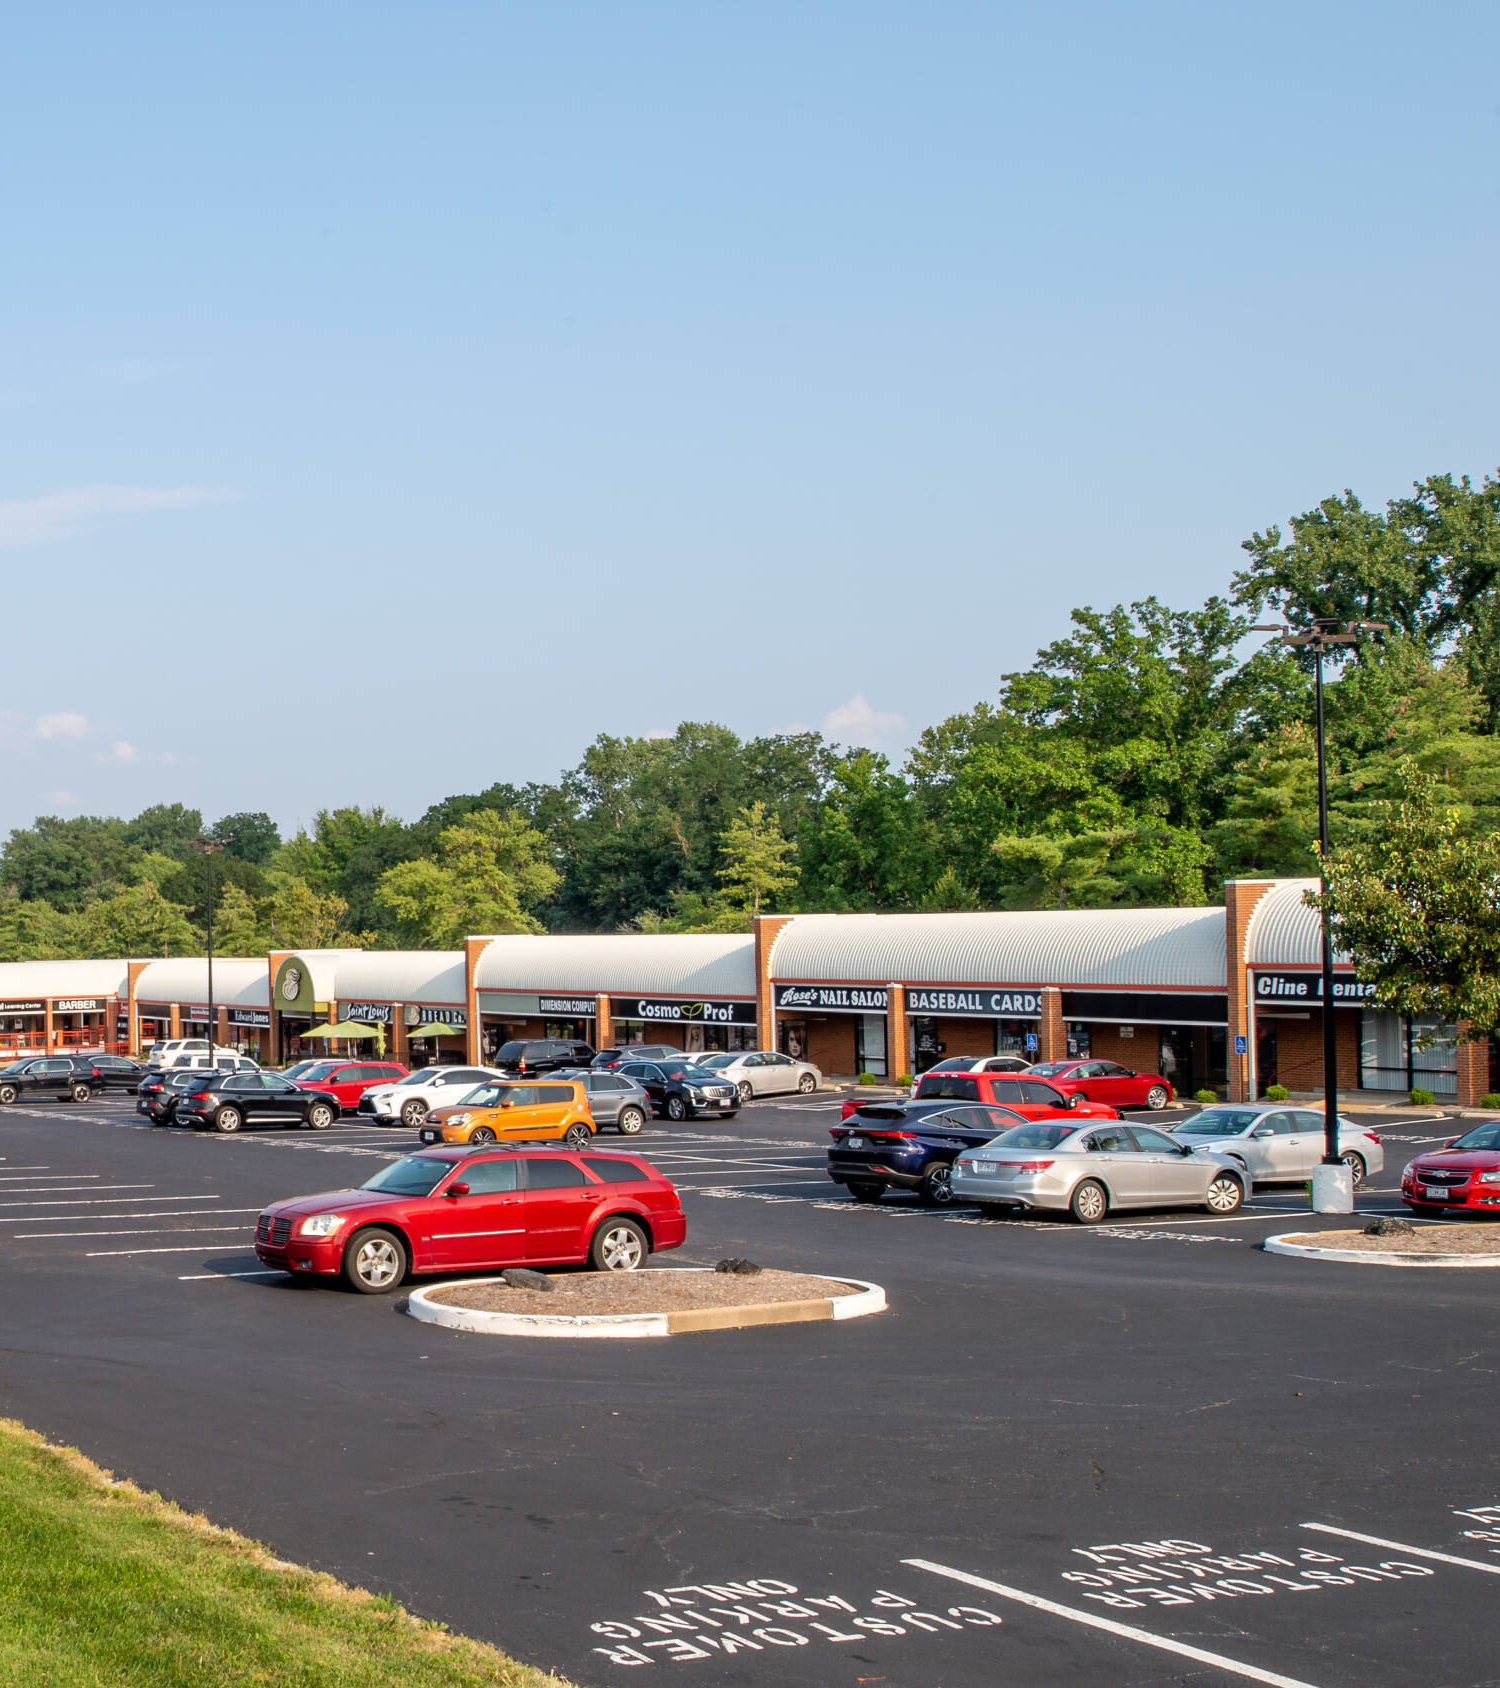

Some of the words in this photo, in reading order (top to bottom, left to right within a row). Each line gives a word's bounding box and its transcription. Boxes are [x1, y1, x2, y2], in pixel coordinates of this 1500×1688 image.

[780, 987, 818, 1005] Rose's
[820, 990, 850, 1006] NAIL
[1257, 976, 1308, 996] Cline
[1317, 977, 1377, 997] enta
[58, 1000, 96, 1010] BARBER
[541, 999, 571, 1012] DIMENSION
[571, 1000, 596, 1013] COMPUT
[638, 1000, 681, 1019] Cosmo
[703, 1003, 734, 1021] Prof
[909, 992, 984, 1010] BASEBALL
[990, 994, 1042, 1012] CARDS
[422, 1010, 451, 1022] BREAD
[1071, 1539, 1213, 1563] ONLY
[1061, 1547, 1344, 1587] PARKING
[643, 1578, 799, 1608] ONLY
[1082, 1562, 1435, 1609] CUSTOMER
[590, 1590, 917, 1639] PARKING
[593, 1606, 1003, 1666] CUSTOMER
